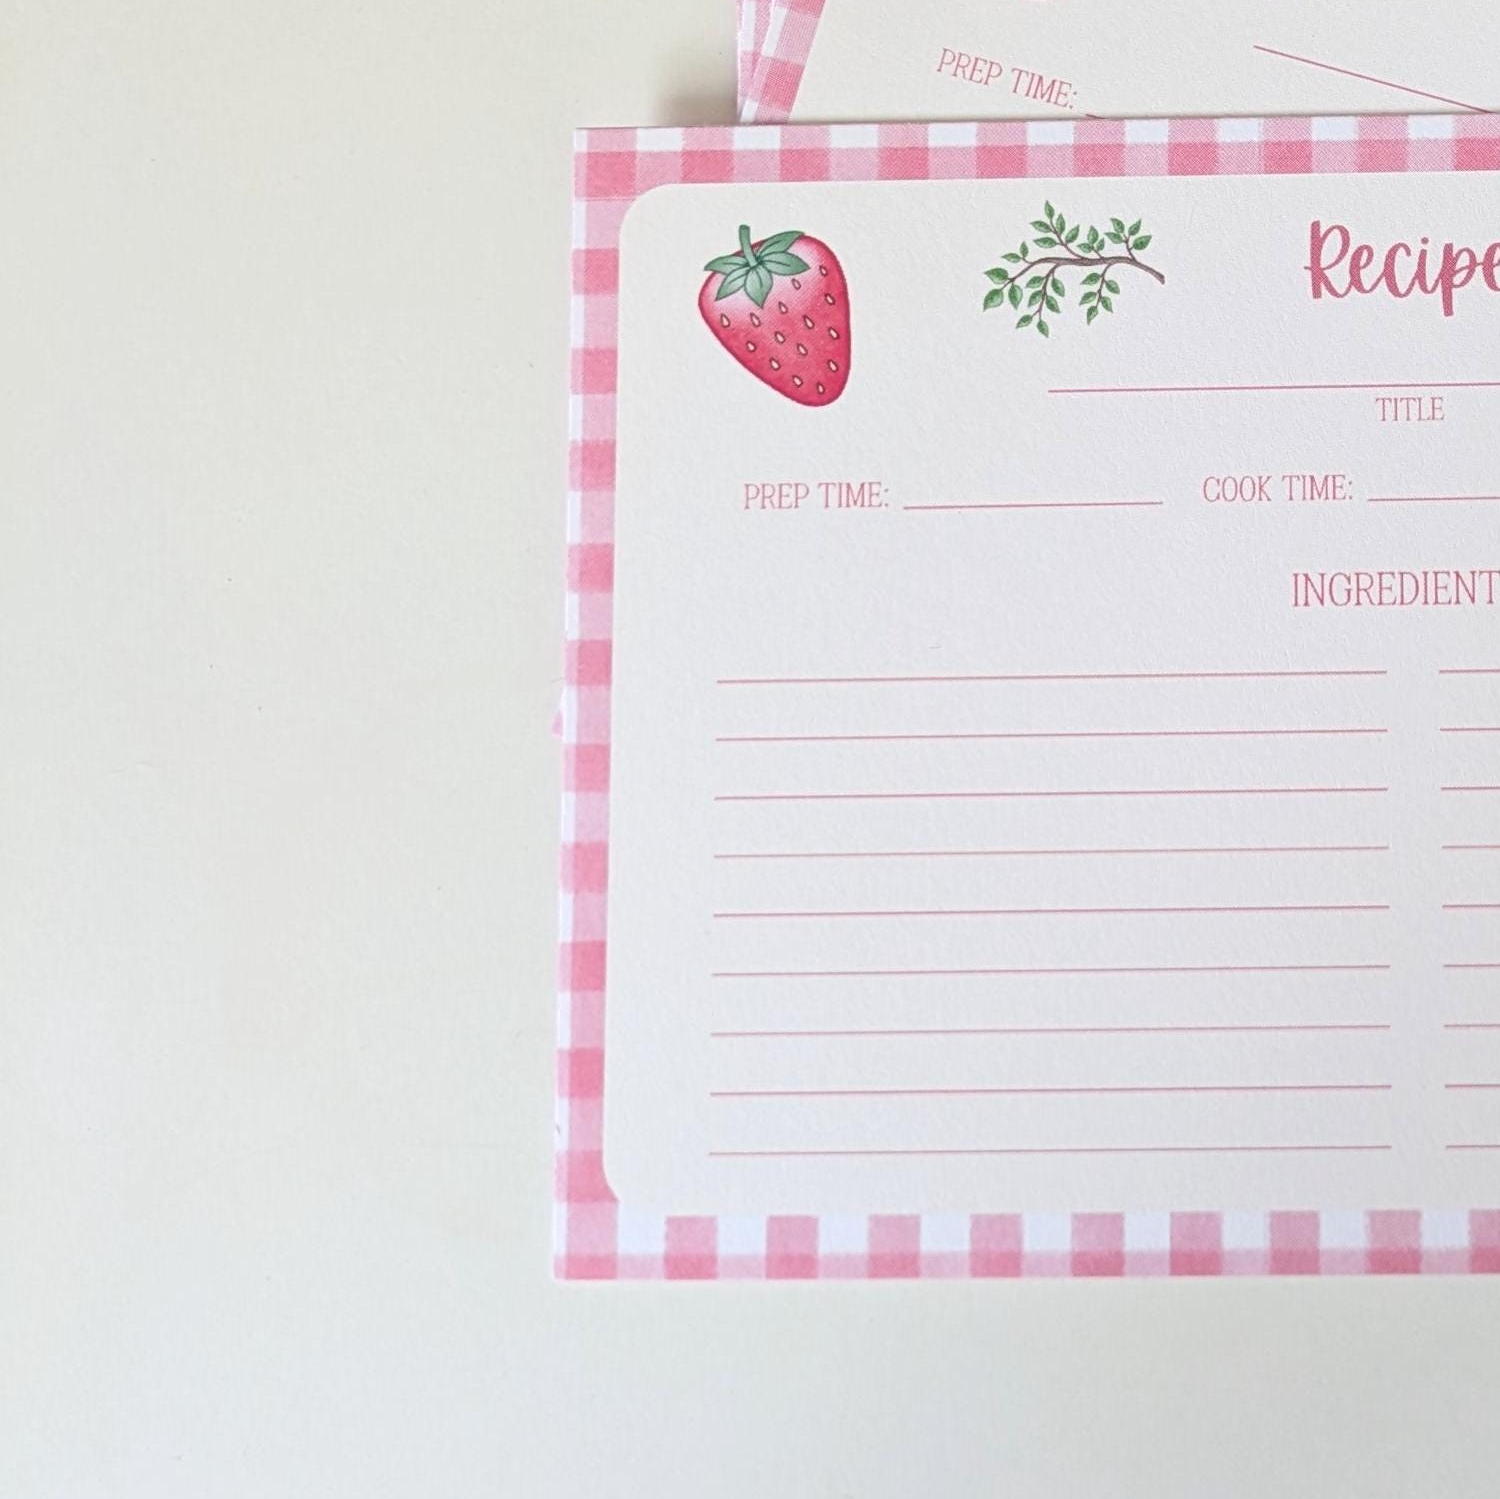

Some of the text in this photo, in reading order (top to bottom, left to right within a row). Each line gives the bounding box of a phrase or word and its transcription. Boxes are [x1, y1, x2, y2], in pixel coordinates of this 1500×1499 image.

[936, 47, 1078, 110] PREP TIME:
[1375, 396, 1445, 422] TITLE
[743, 482, 810, 510] PREP
[817, 481, 889, 509] TIME:
[1202, 475, 1273, 503] COOK
[1281, 474, 1353, 502] TIME:
